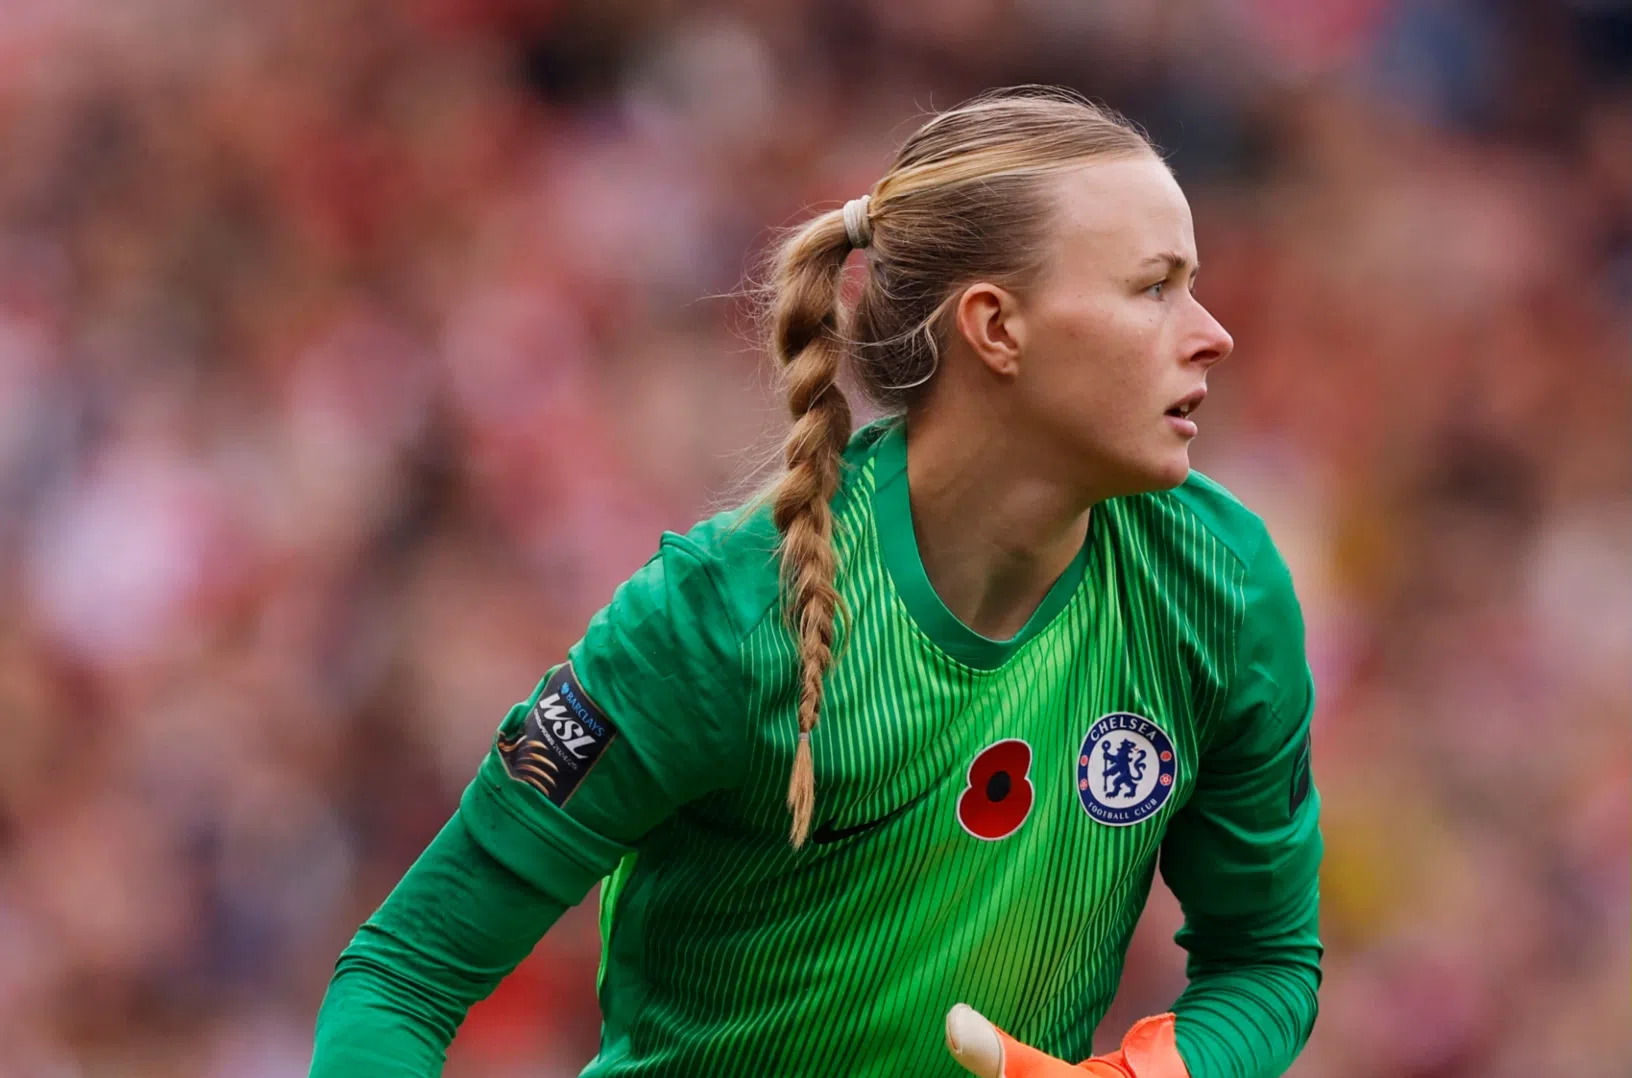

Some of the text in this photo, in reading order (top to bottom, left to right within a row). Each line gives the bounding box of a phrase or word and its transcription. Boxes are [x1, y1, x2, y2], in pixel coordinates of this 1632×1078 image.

[539, 693, 596, 758] WSL
[567, 691, 604, 737] BARCLAYS
[1090, 717, 1157, 741] CHELSEA
[1088, 798, 1158, 820] FOOTBALL CLUB
